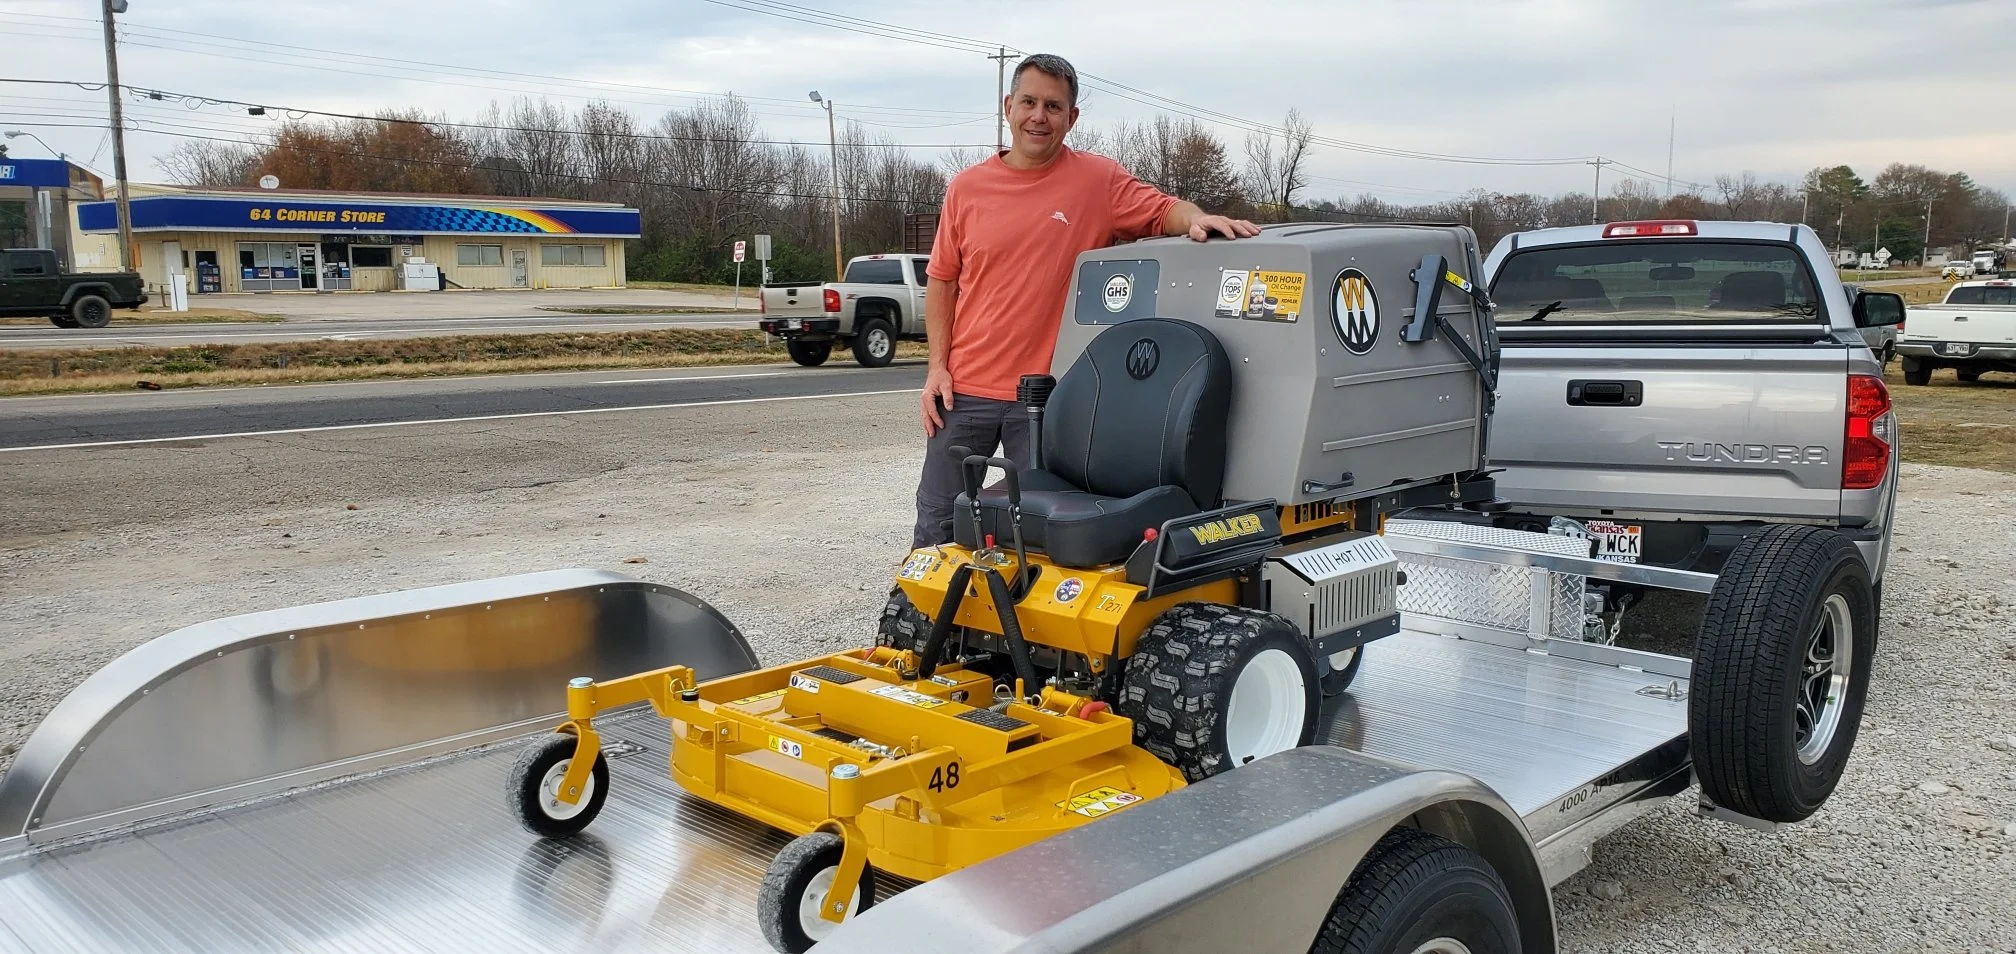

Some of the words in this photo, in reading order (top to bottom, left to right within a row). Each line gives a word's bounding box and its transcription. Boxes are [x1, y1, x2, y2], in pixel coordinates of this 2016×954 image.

[250, 208, 271, 220] 64
[276, 208, 336, 222] CORNER
[340, 210, 385, 223] STORE
[1279, 276, 1303, 284] HOUR
[1280, 283, 1301, 291] Change
[1107, 286, 1128, 297] GHS
[1224, 285, 1241, 294] TOPS
[1657, 441, 1829, 465] TUNDRA
[1188, 513, 1265, 546] WALKER
[1585, 523, 1625, 534] rkansas
[1606, 534, 1639, 554] WCK
[1331, 549, 1357, 566] HOT
[1596, 554, 1637, 564] KANSAS
[927, 761, 960, 793] 48
[1558, 788, 1588, 813] 4000
